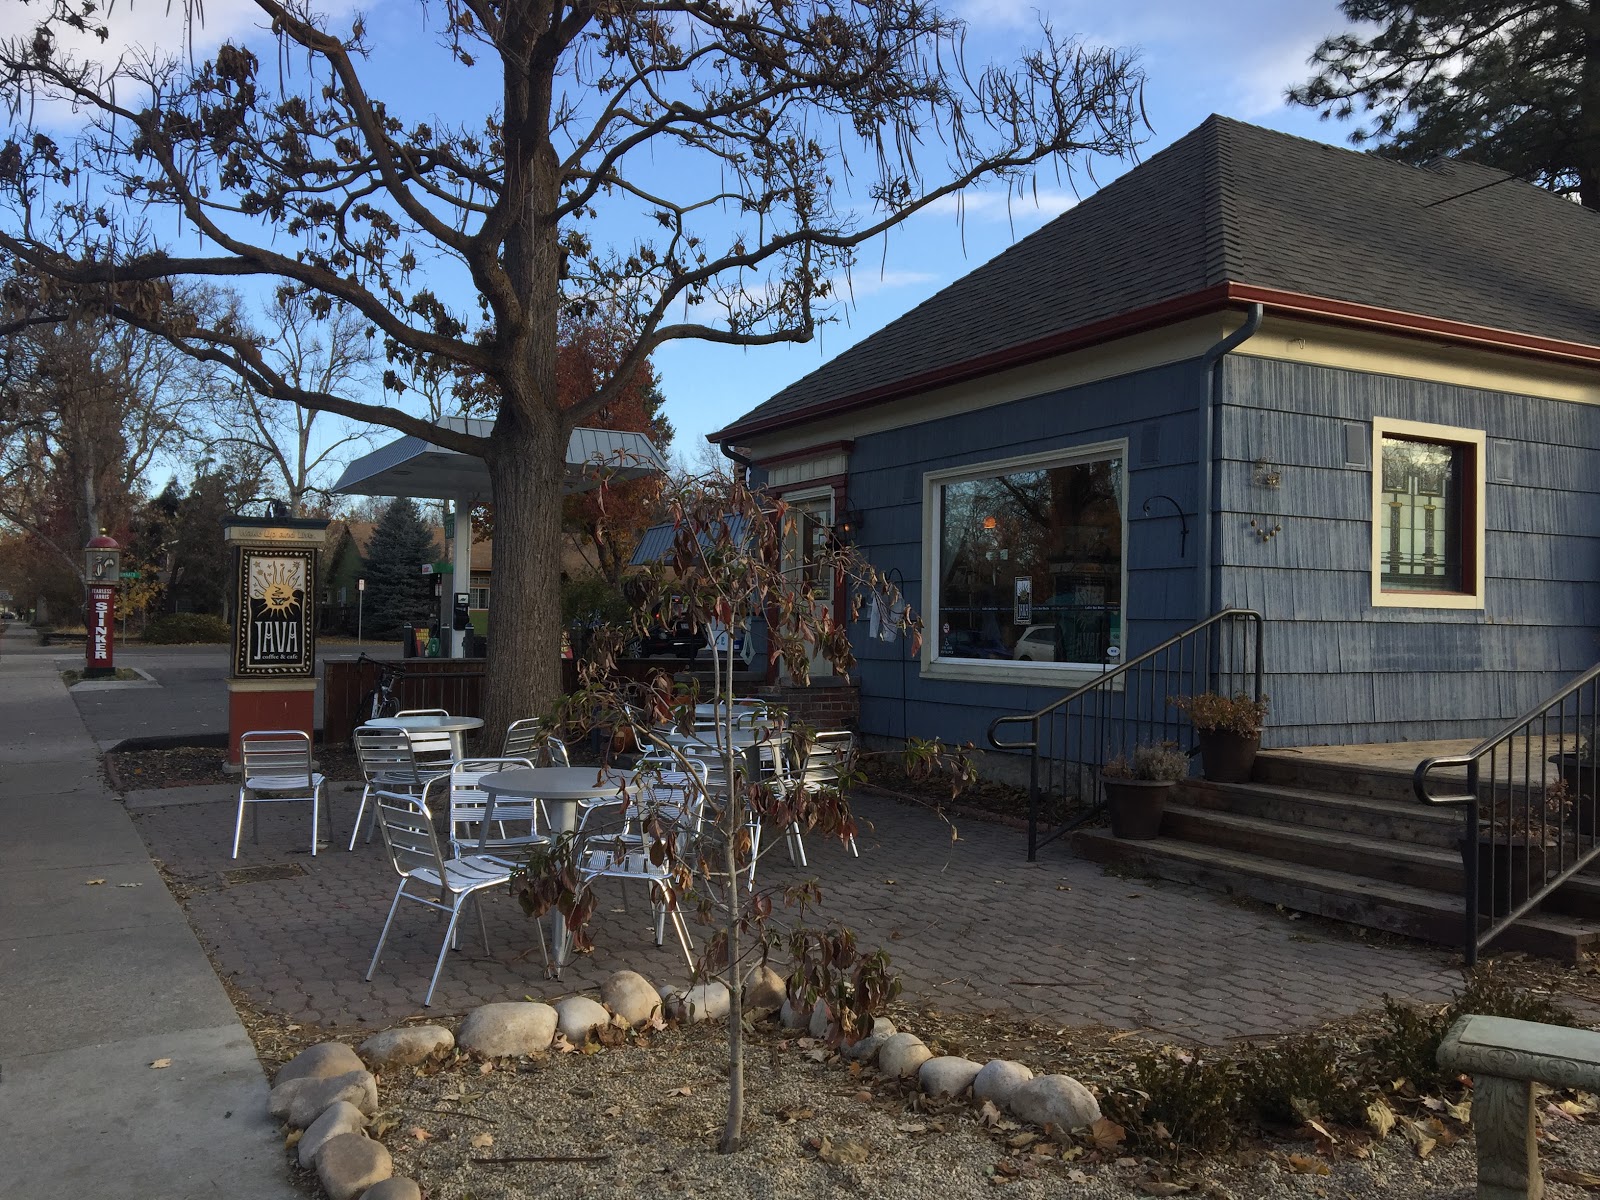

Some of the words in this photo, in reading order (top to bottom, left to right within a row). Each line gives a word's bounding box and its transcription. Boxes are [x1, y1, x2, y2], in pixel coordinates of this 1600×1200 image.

[239, 530, 262, 538] Wake
[264, 529, 276, 540] Up
[278, 530, 295, 539] and
[95, 601, 108, 660] STINKER
[254, 621, 298, 660] JAVA
